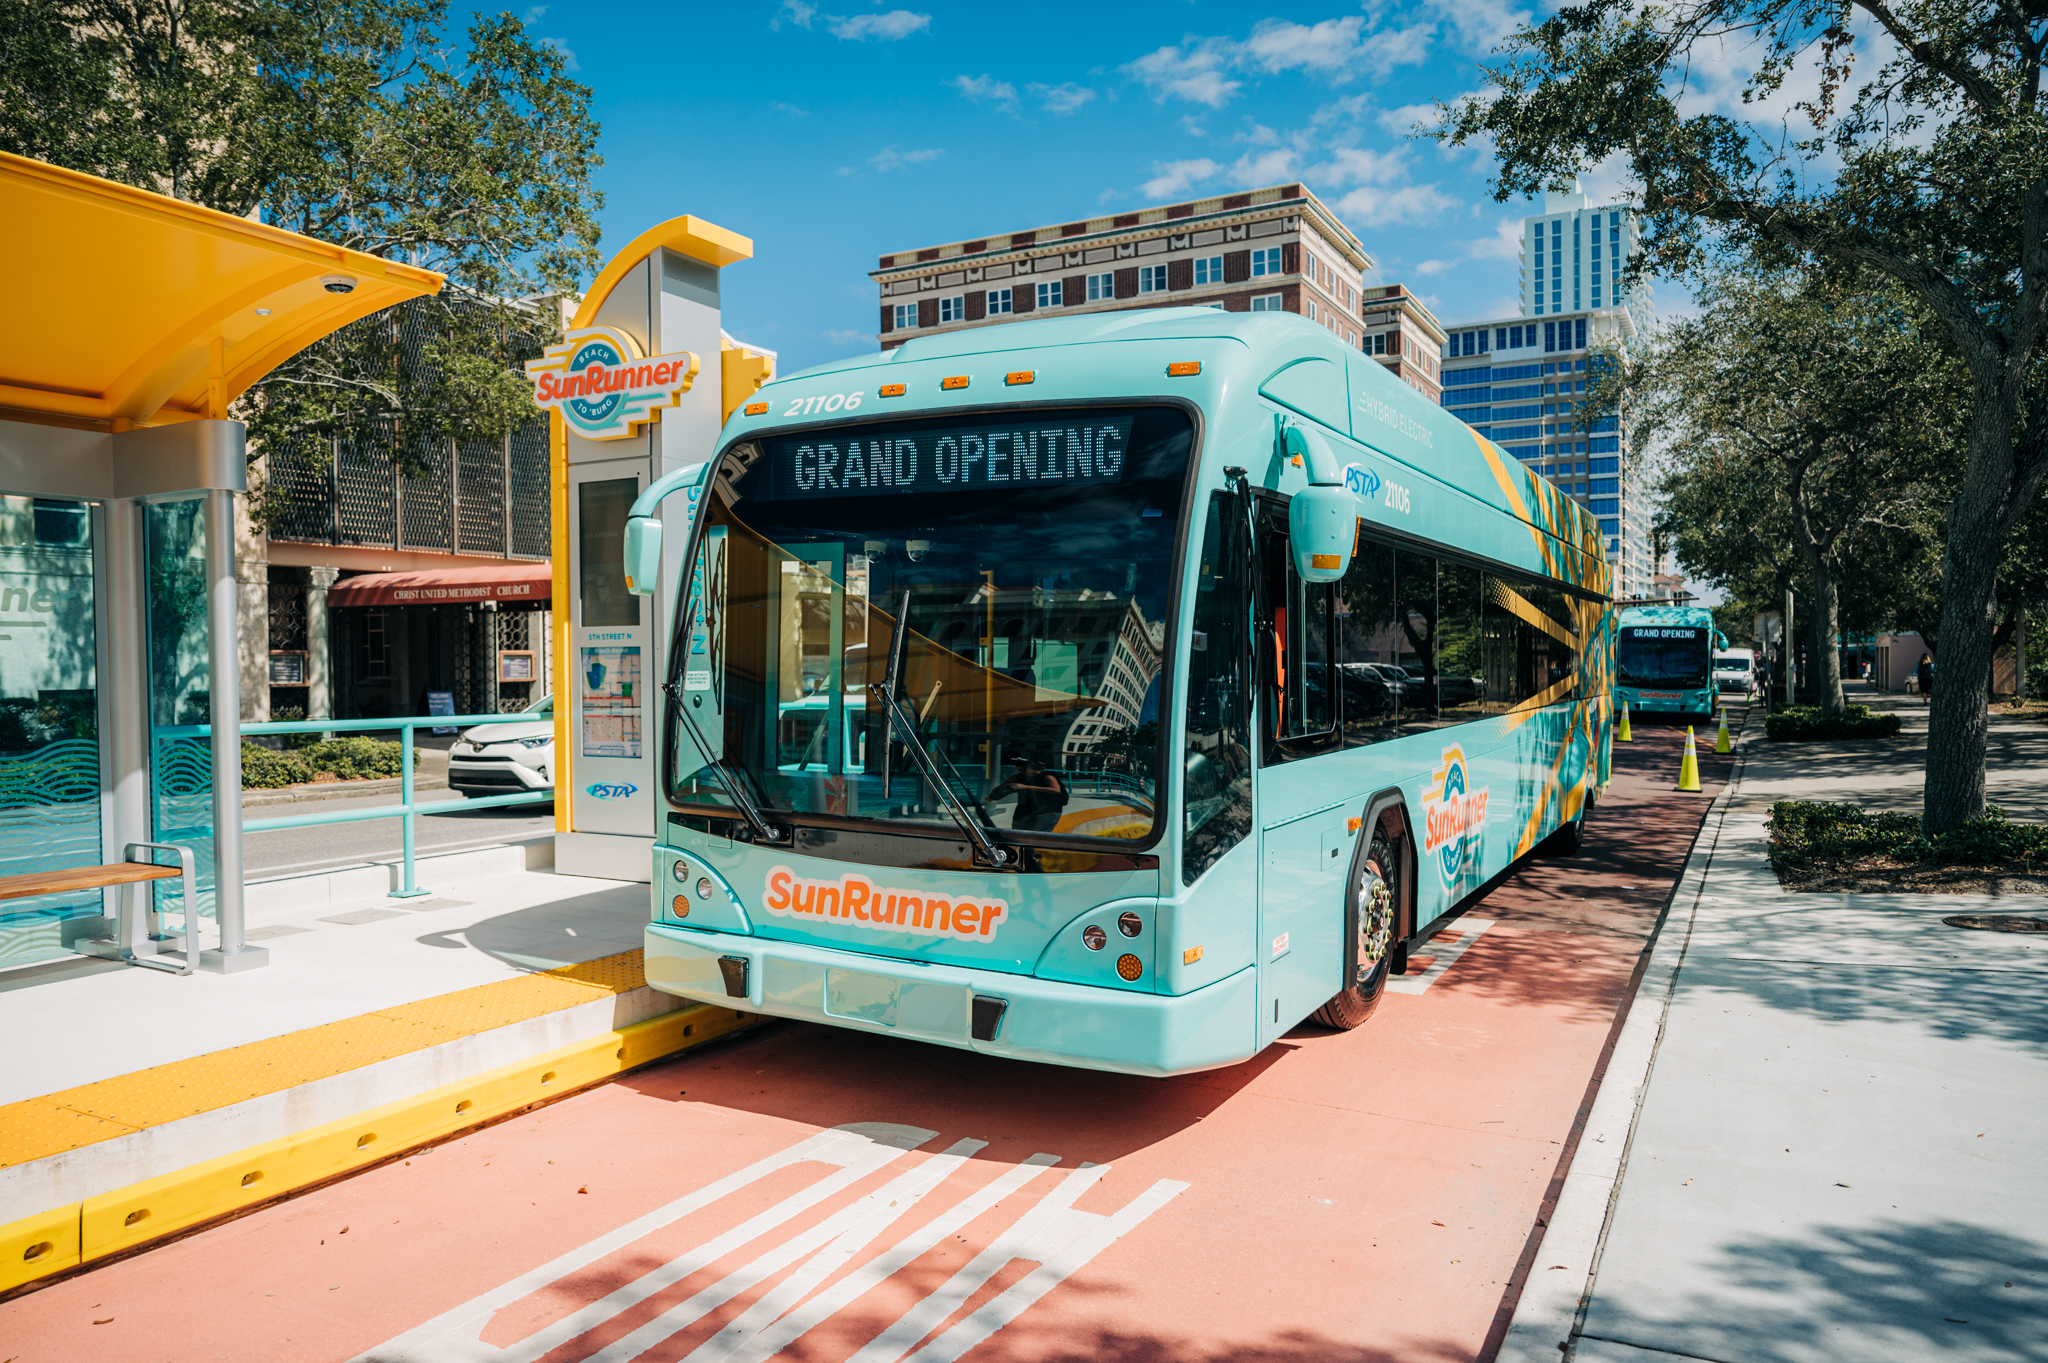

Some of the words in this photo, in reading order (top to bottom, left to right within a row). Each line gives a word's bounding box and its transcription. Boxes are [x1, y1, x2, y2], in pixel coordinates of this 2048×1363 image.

[578, 349, 610, 364] BEACH
[537, 359, 684, 402] SunRunner
[577, 402, 587, 414] TO
[783, 391, 865, 418] 21106
[1366, 394, 1398, 429] HYBRID
[1399, 413, 1433, 449] ELECTRIC
[795, 438, 918, 490] GRAND
[935, 425, 1122, 484] OPENING
[1344, 465, 1379, 500] PSTA
[1384, 479, 1411, 515] 21106
[393, 589, 420, 600] CHRIST
[420, 588, 447, 599] UNITED
[448, 587, 492, 598] METHODIST
[496, 584, 530, 596] CHURCH
[588, 633, 601, 641] 5TH
[602, 632, 626, 641] STREET
[626, 632, 632, 640] N
[1633, 628, 1659, 638] GRAND
[1661, 629, 1695, 639] OPENING
[691, 634, 706, 655] N
[1638, 690, 1683, 700] SunRunner
[590, 784, 633, 798] PSTA
[1447, 770, 1462, 791] BEACH
[1426, 791, 1488, 850] SunRunner
[767, 871, 1002, 936] SunRunner
